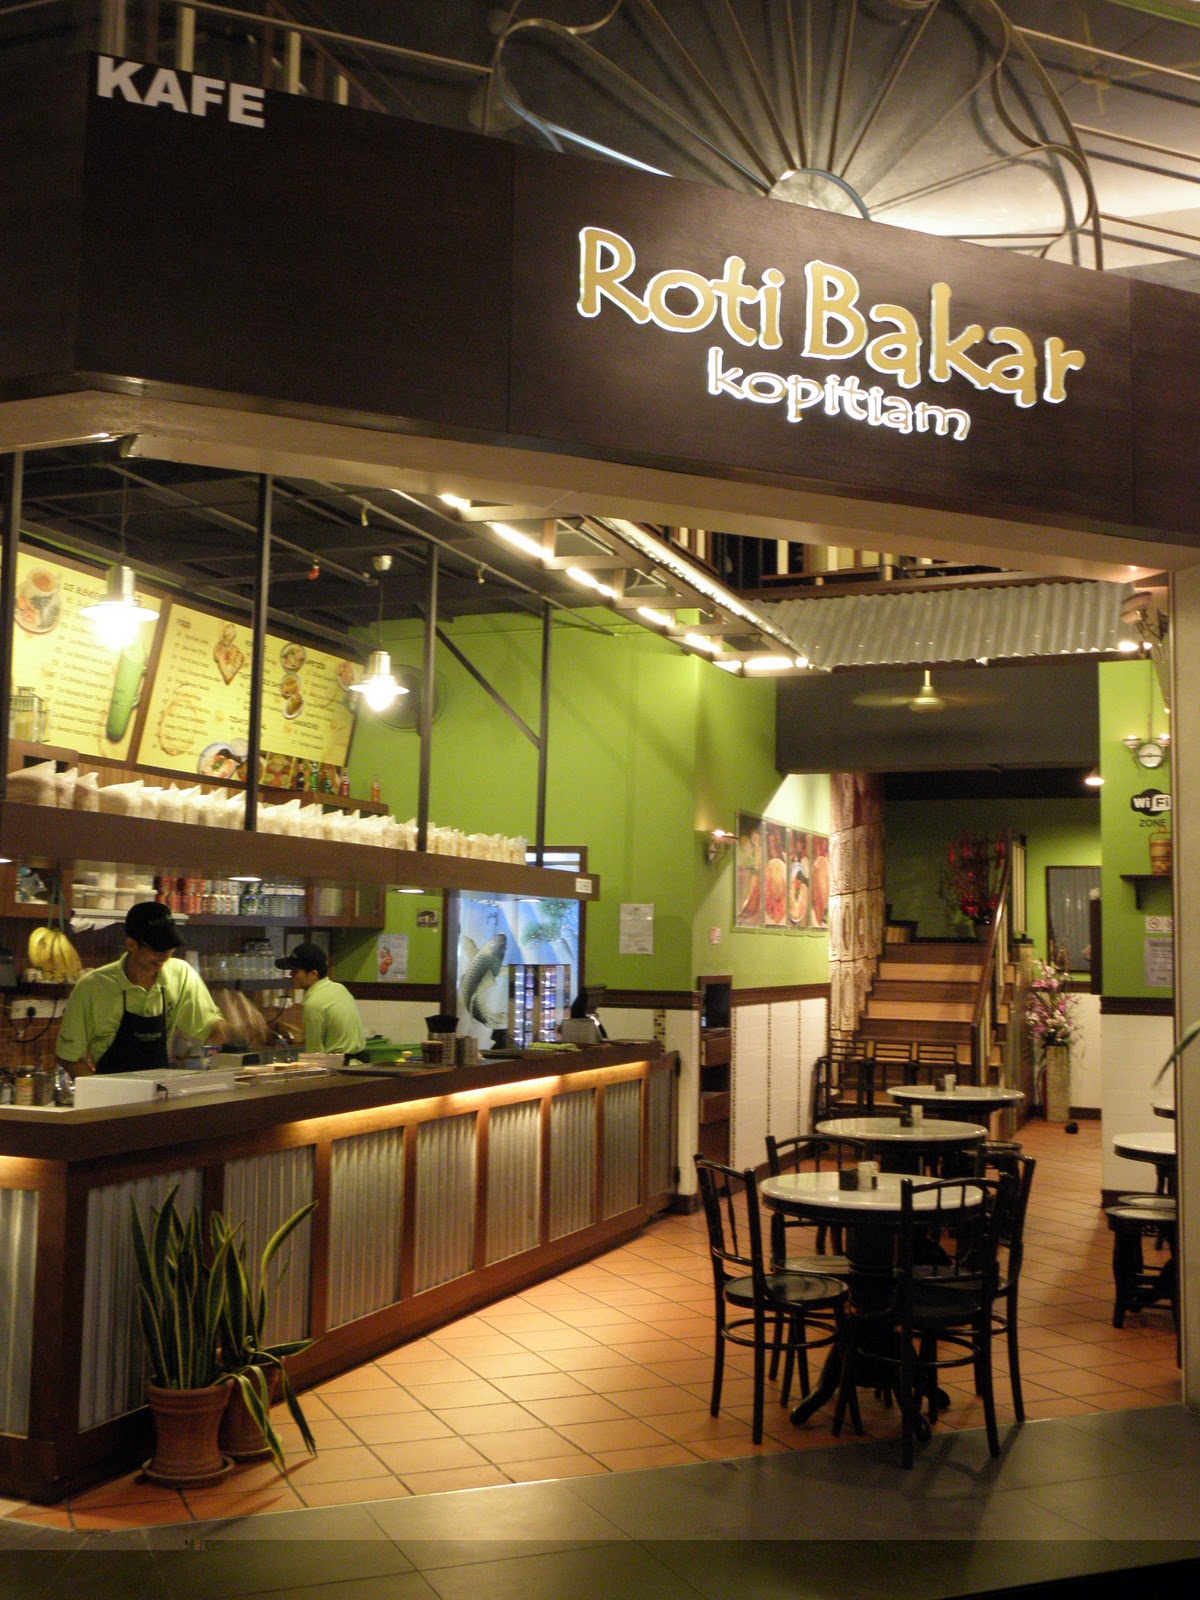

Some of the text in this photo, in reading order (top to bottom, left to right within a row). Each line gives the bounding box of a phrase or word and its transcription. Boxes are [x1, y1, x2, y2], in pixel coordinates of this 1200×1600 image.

[97, 54, 265, 129] KAFE
[576, 226, 1086, 407] Roti Bakar
[707, 346, 971, 441] kopitiam
[1139, 818, 1167, 828] ZONE
